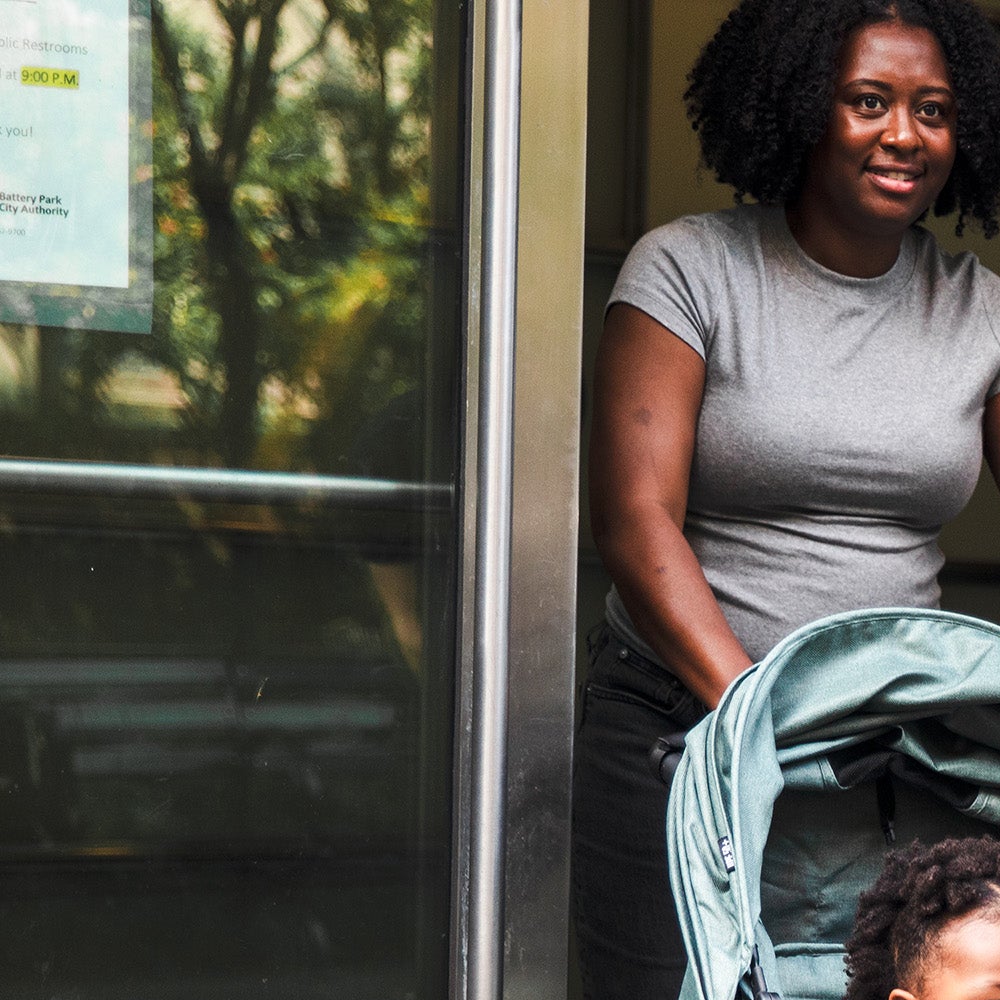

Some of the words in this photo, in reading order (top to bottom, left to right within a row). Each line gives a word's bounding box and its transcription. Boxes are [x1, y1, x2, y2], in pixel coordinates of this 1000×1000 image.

[22, 38, 88, 55] Restrooms
[6, 70, 17, 80] at
[21, 70, 49, 83] 9:00
[52, 72, 79, 86] P.M.
[5, 126, 33, 138] you!
[0, 192, 37, 205] Battery
[39, 194, 62, 205] Park
[0, 203, 18, 216] City
[21, 204, 69, 218] Authority
